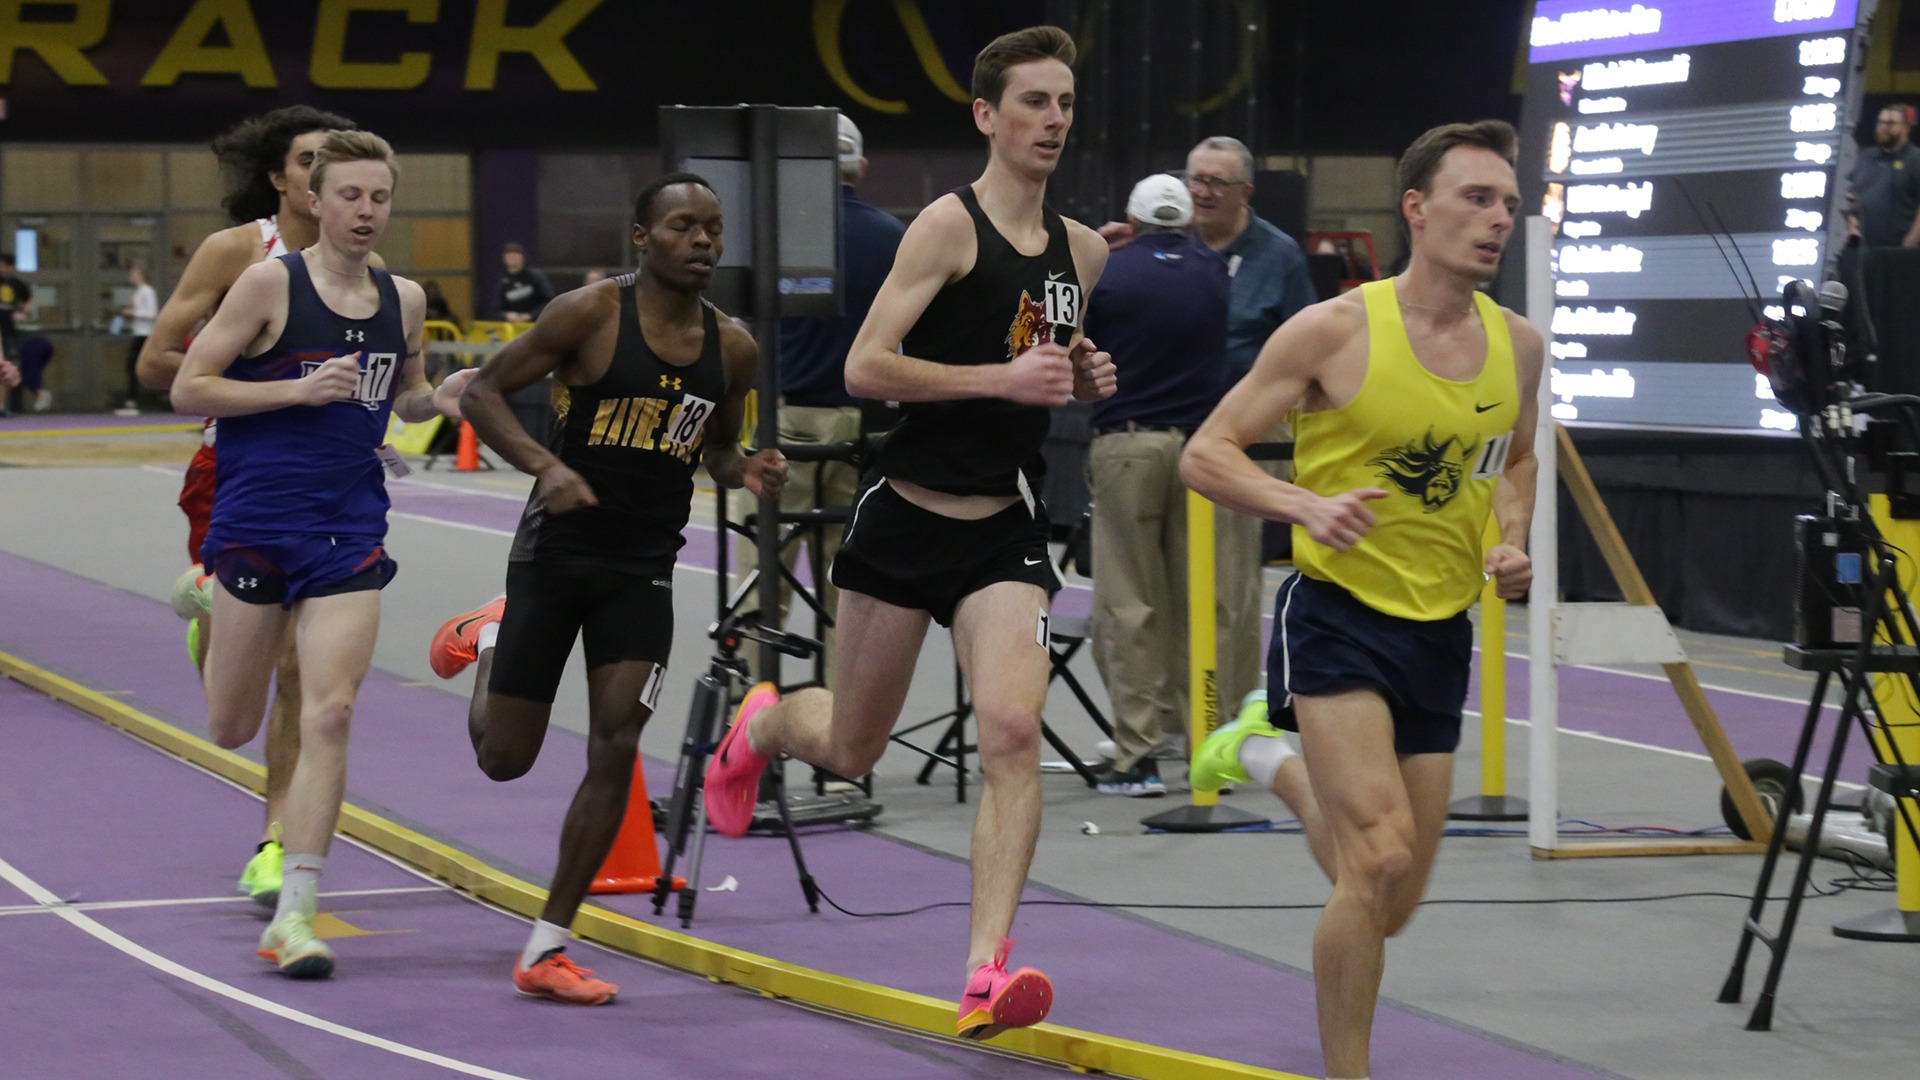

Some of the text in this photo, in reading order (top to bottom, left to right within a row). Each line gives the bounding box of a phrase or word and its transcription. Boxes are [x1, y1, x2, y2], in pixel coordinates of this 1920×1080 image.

[0, 0, 598, 91] RACK
[1048, 283, 1075, 324] 13
[370, 356, 392, 399] 17
[672, 400, 706, 443] 18
